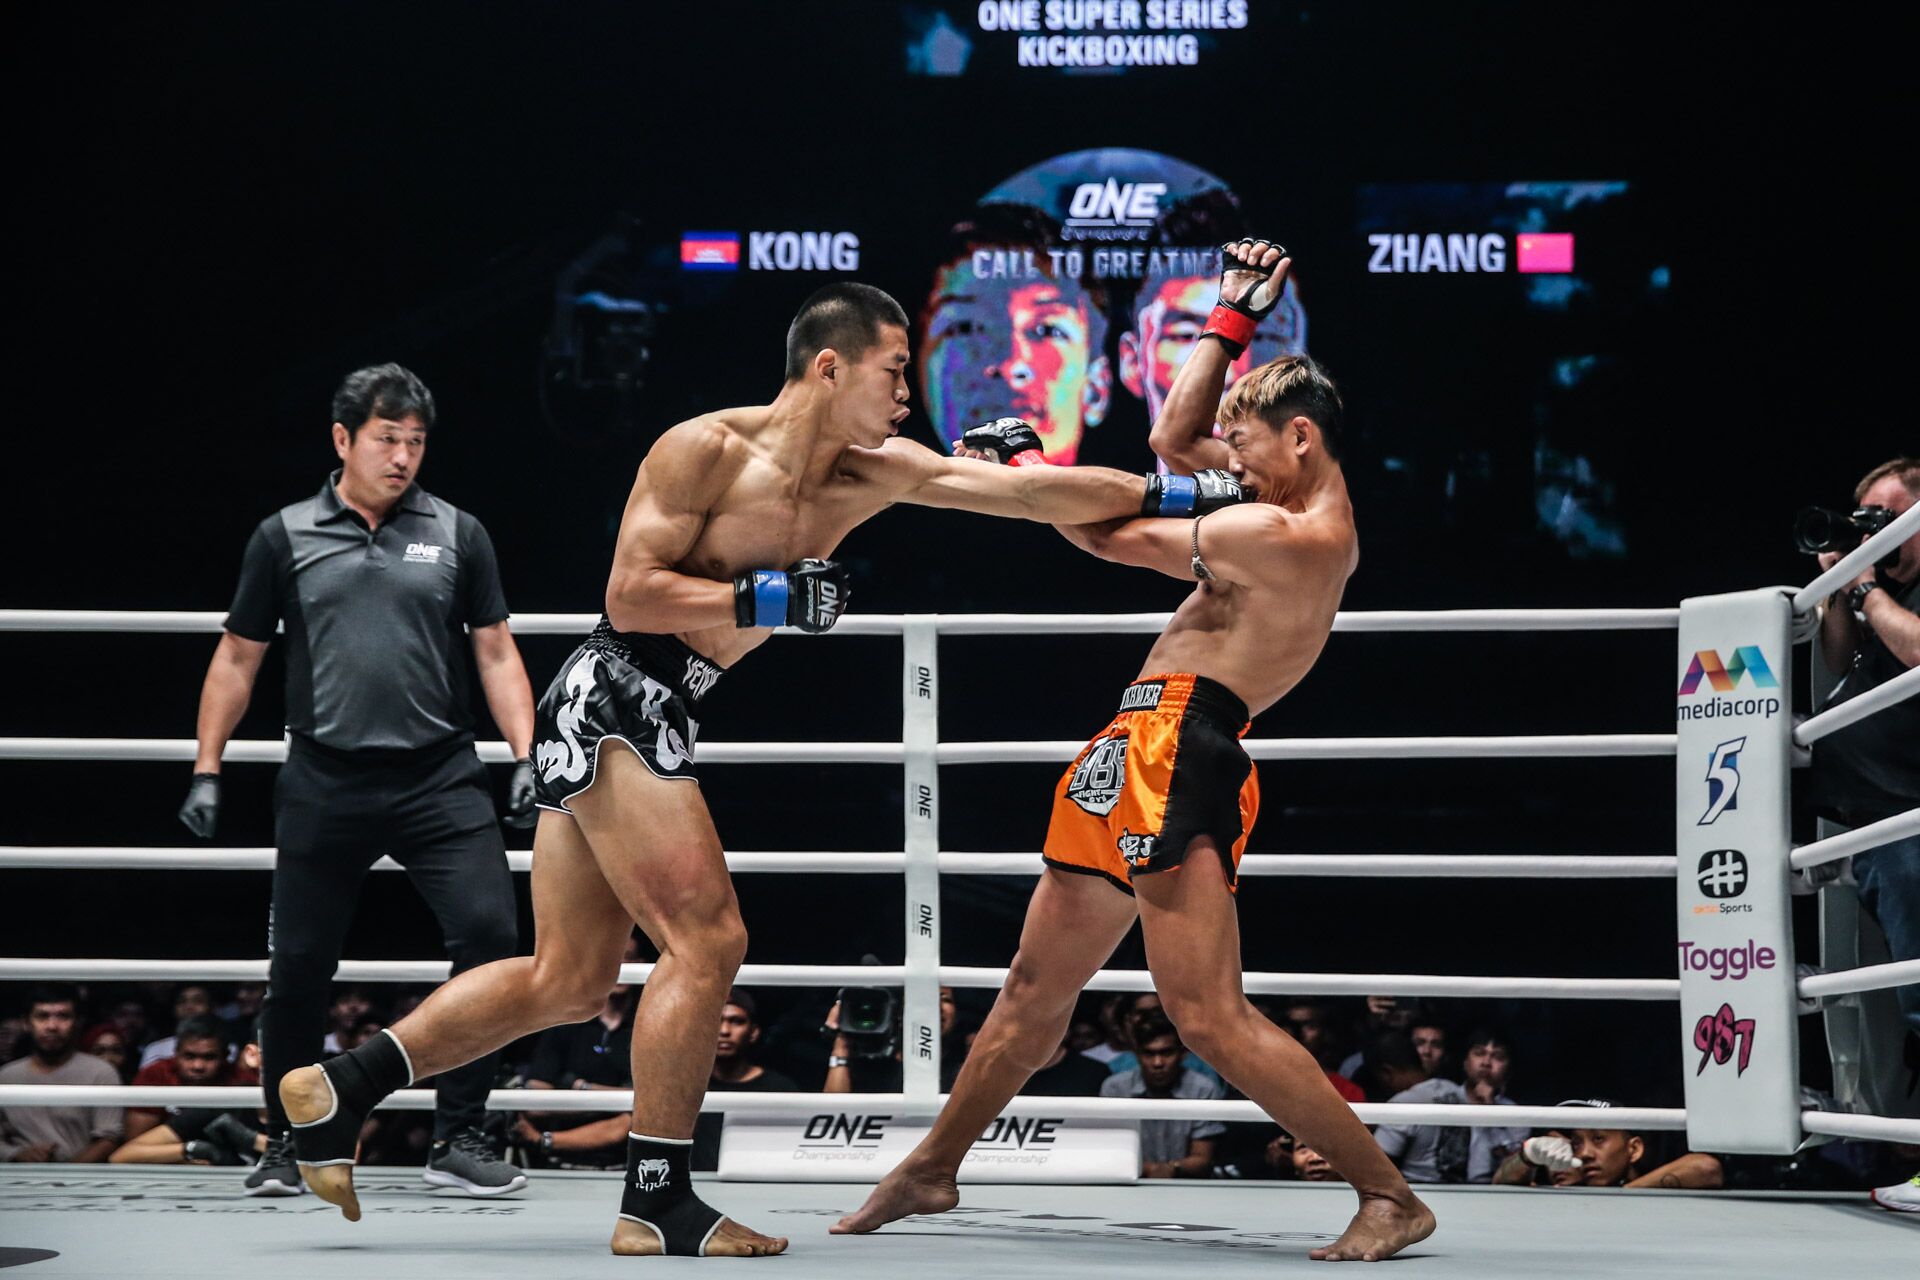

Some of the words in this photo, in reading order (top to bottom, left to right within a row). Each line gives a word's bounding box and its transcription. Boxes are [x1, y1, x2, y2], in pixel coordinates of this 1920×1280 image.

[978, 0, 1041, 31] ONE
[1045, 0, 1142, 30] SUPER
[1145, 0, 1249, 30] SERIES
[1017, 34, 1199, 67] KICKBOXING
[1069, 177, 1167, 225] ONE
[748, 231, 860, 271] KONG
[972, 249, 1037, 279] CALL
[1047, 249, 1084, 278] TO
[1367, 232, 1507, 273] ZHANG
[405, 542, 443, 557] ONE
[817, 580, 839, 627] ONE
[917, 666, 932, 700] ONE
[1677, 697, 1780, 720] mediacorp
[1696, 735, 1747, 826] 5
[918, 784, 932, 819] ONE
[919, 904, 934, 939] ONE
[1678, 938, 1776, 981] Toggle
[919, 1025, 933, 1061] ONE
[1693, 1002, 1756, 1079] 987
[803, 1112, 893, 1146] ONE
[976, 1116, 1065, 1150] ONE
